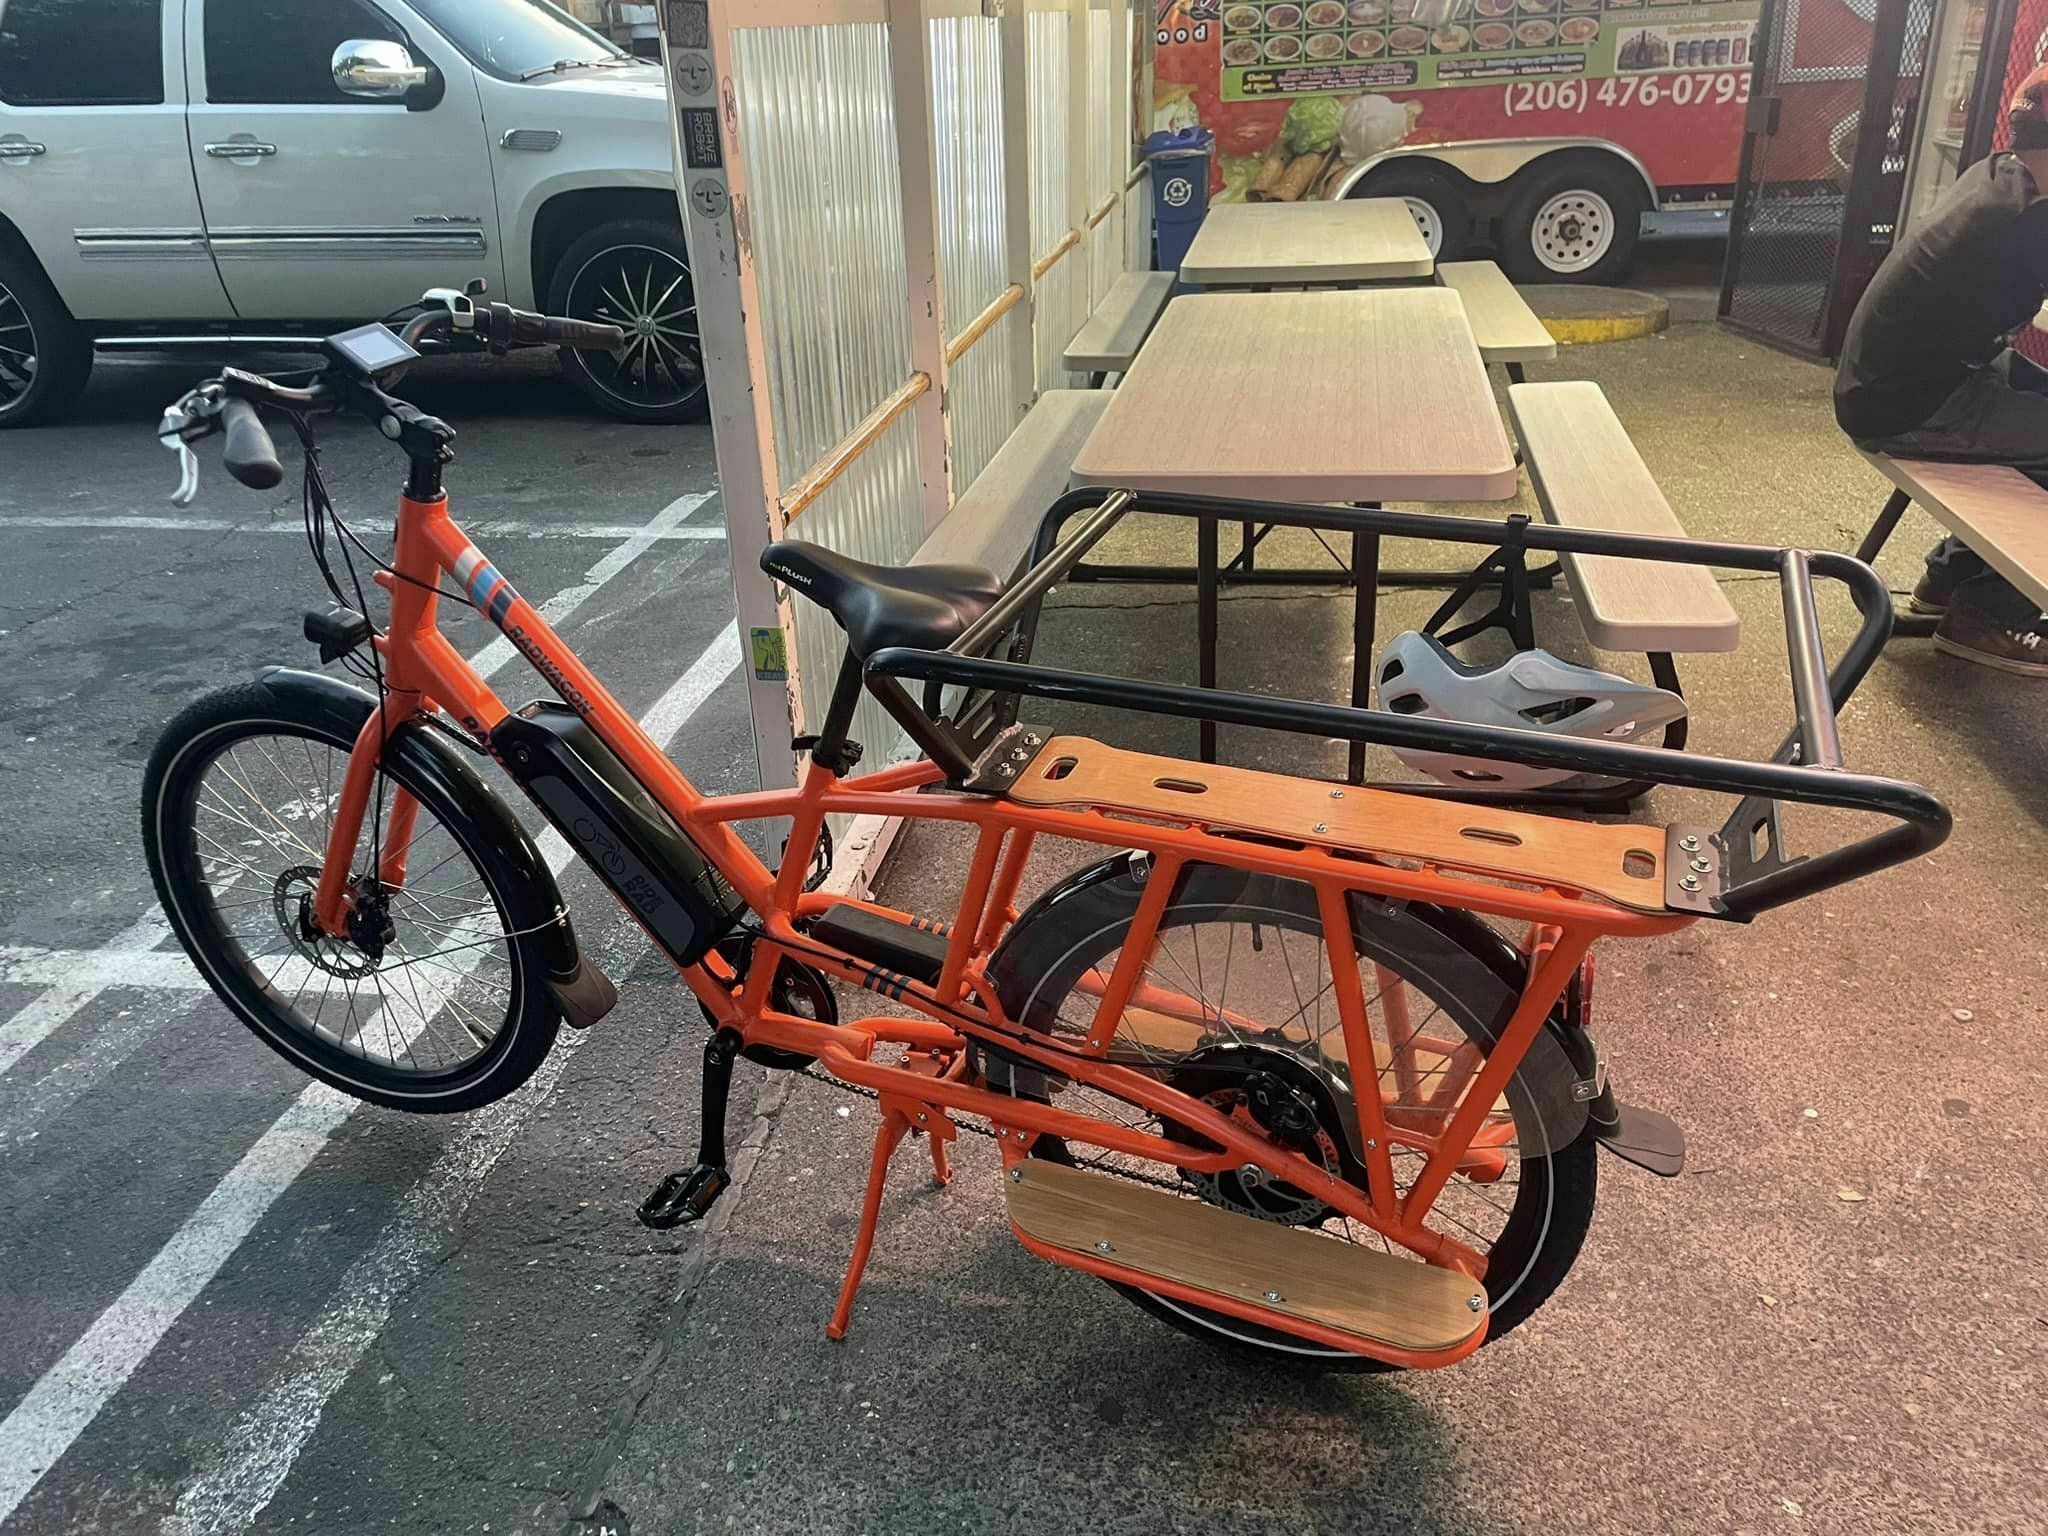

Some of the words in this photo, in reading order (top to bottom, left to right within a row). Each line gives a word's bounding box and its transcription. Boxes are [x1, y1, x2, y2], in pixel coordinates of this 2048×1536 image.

[1504, 79, 1588, 117] (206)
[1596, 73, 1751, 107] 476-0793
[694, 112, 705, 160] ROBOT
[702, 112, 717, 163] BRAVE
[781, 565, 812, 585] PLUSH
[509, 625, 595, 715] RADWAGON
[623, 879, 657, 914] RAD
[631, 874, 665, 911] RIDE
